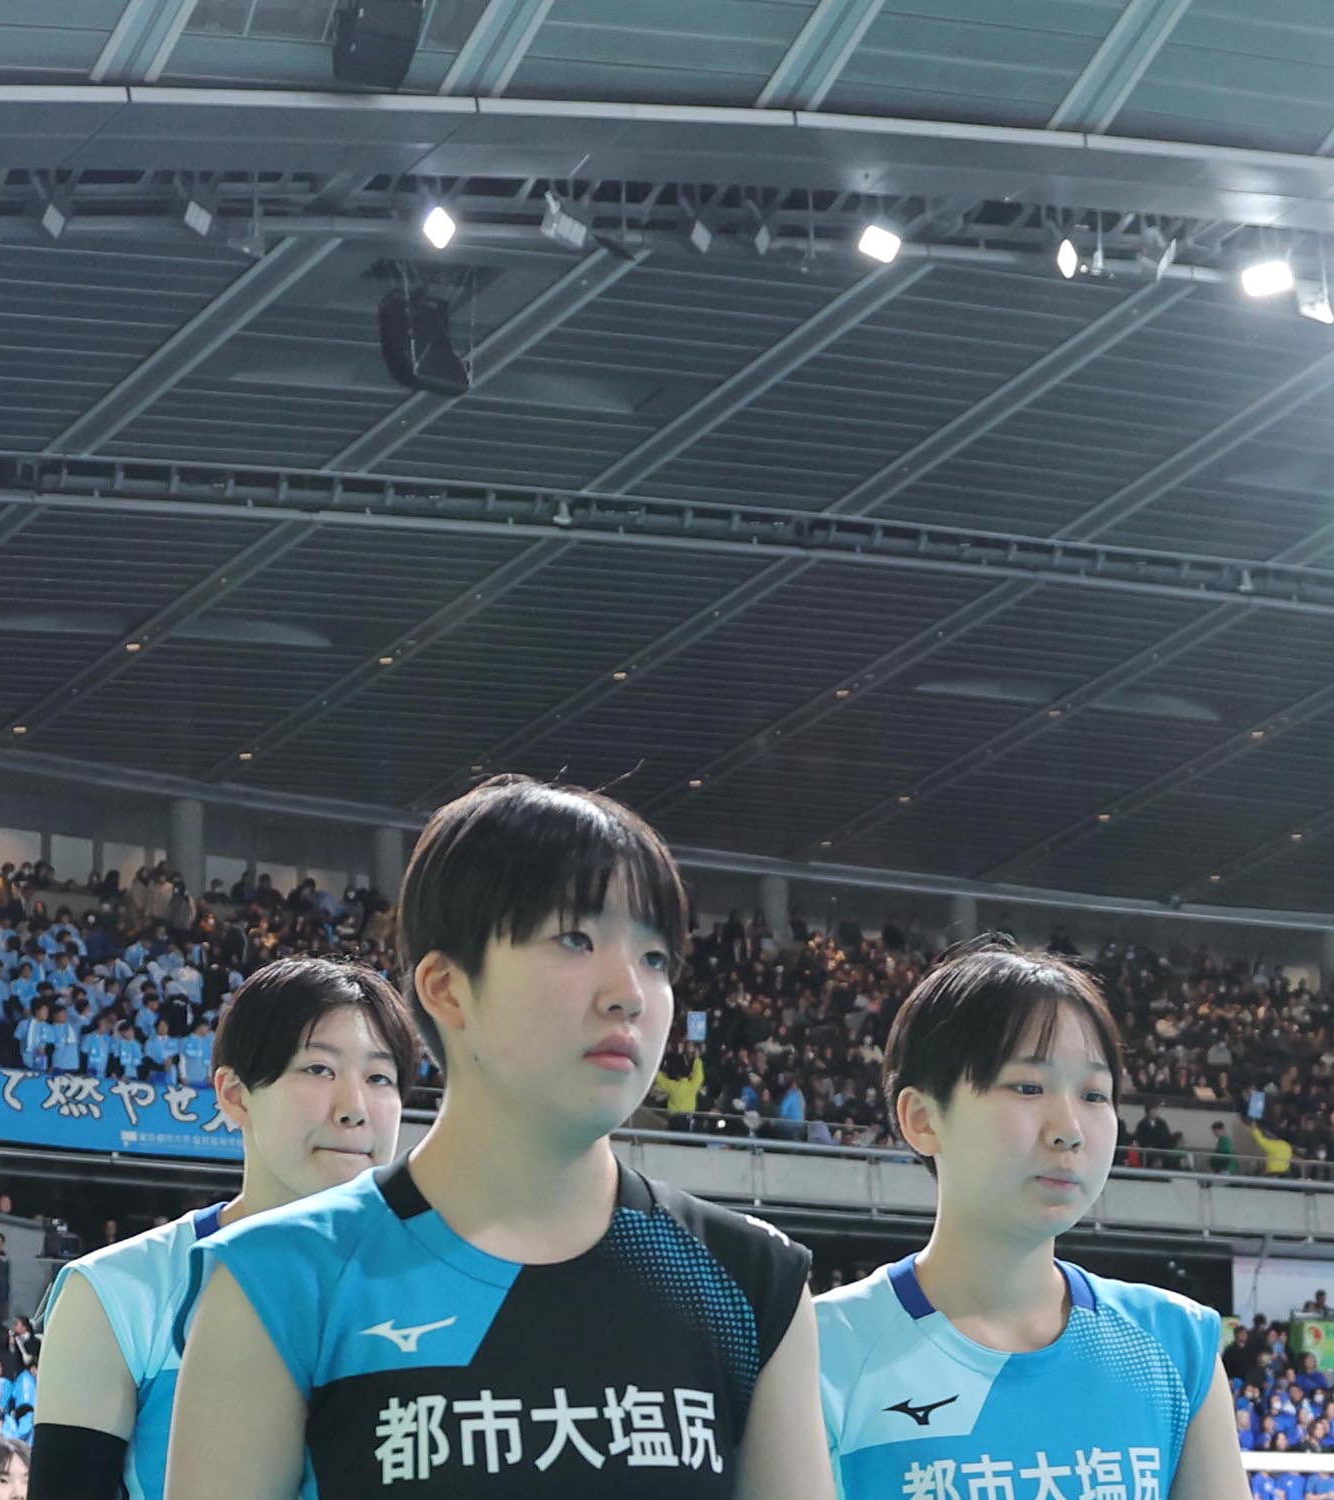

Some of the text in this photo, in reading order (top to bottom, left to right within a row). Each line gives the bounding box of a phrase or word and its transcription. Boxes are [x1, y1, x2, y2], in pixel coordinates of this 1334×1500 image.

[373, 1385, 724, 1484] 都市大塩尻
